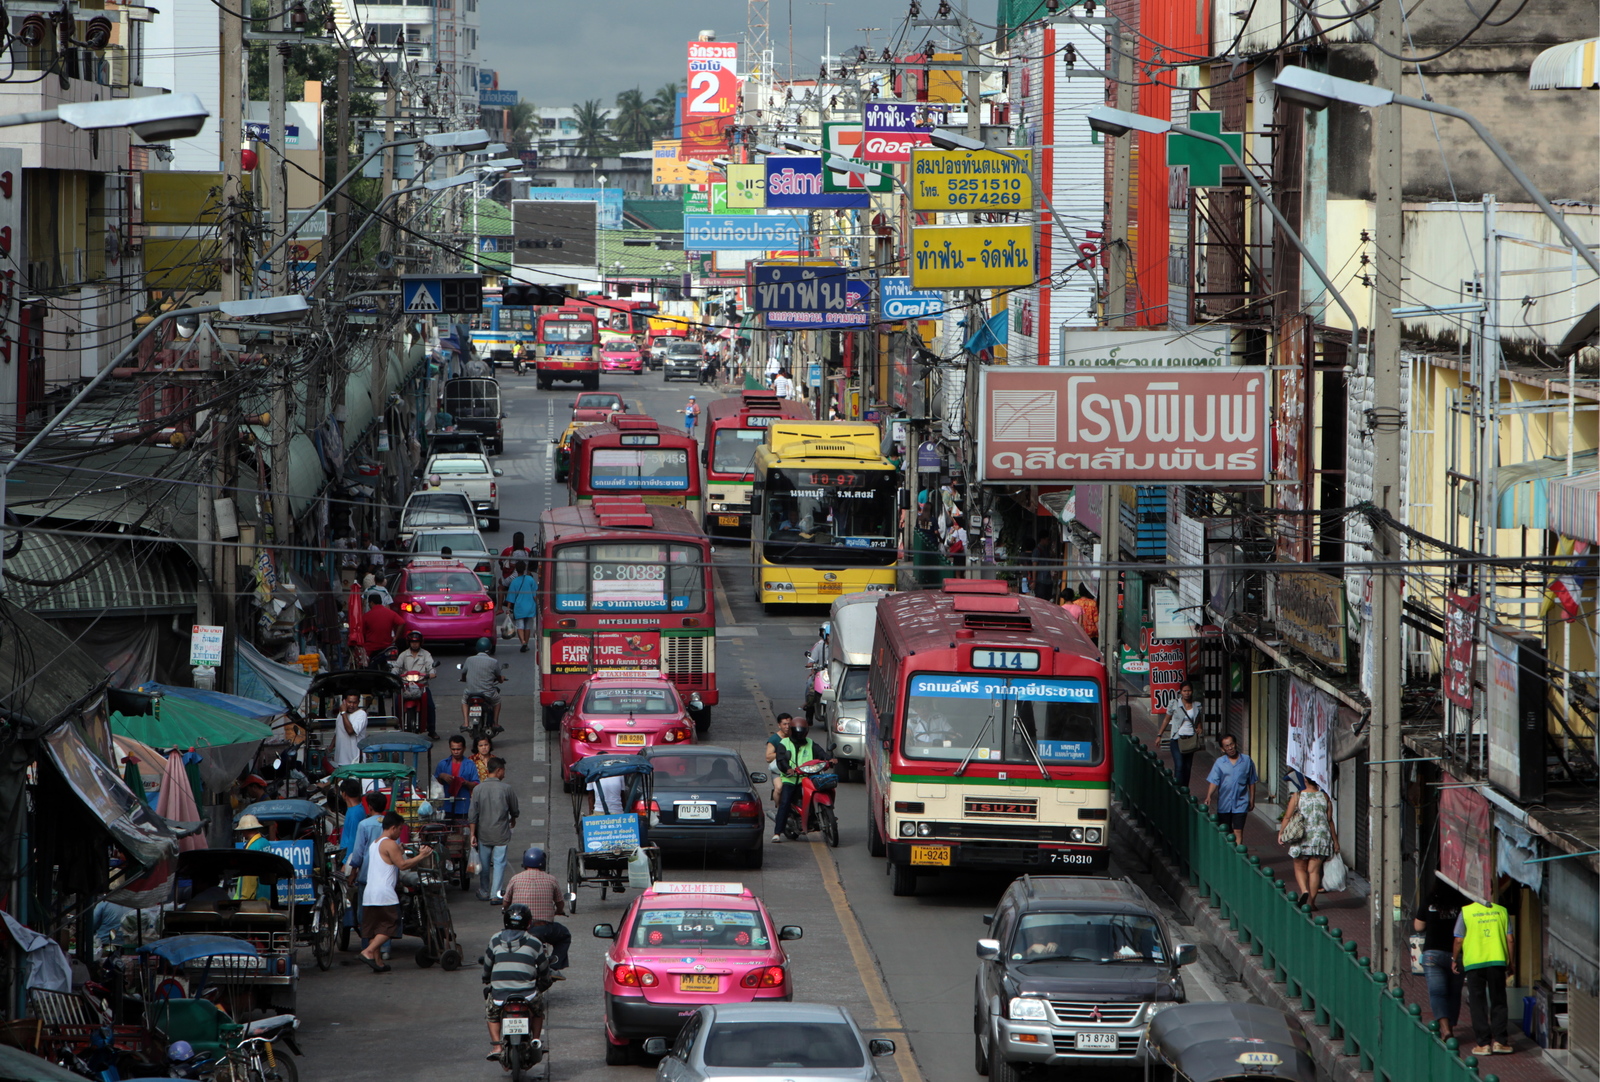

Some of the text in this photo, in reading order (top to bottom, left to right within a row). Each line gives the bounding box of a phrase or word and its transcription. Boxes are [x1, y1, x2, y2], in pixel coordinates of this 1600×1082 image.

[689, 44, 736, 58] จักรวาล
[690, 72, 720, 112] 2
[916, 153, 1029, 174] สมปองทันตแพทย์
[920, 179, 1021, 197] โทร. 5251510
[948, 193, 1021, 205] 9674269
[690, 220, 804, 245] แว่นท็อปเจริญ
[916, 240, 964, 270] ทำฟัน
[980, 239, 1029, 268] จัดฟัน
[757, 269, 845, 310] ทำฟัน
[888, 301, 943, 317] Oral-B
[1067, 375, 1261, 443] โรงพิมพ์
[991, 446, 1259, 476] ดุสิตสัมพันธ์
[790, 488, 824, 501] นนทบุรี
[562, 646, 623, 655] FURNTURE
[562, 654, 588, 662] FAIR
[988, 652, 1022, 668] 114
[918, 679, 1094, 698] รถเมล์ฟรี จากภาษีประชาชน
[1040, 744, 1052, 757] 114
[972, 804, 1031, 813] ISUZU
[914, 850, 949, 861] 11-9243
[1050, 854, 1093, 864] 7-50310
[669, 884, 726, 893] TAXI-METER
[697, 975, 716, 984] 6527
[1094, 1033, 1115, 1043] 8738
[1248, 1054, 1273, 1062] TAXI
